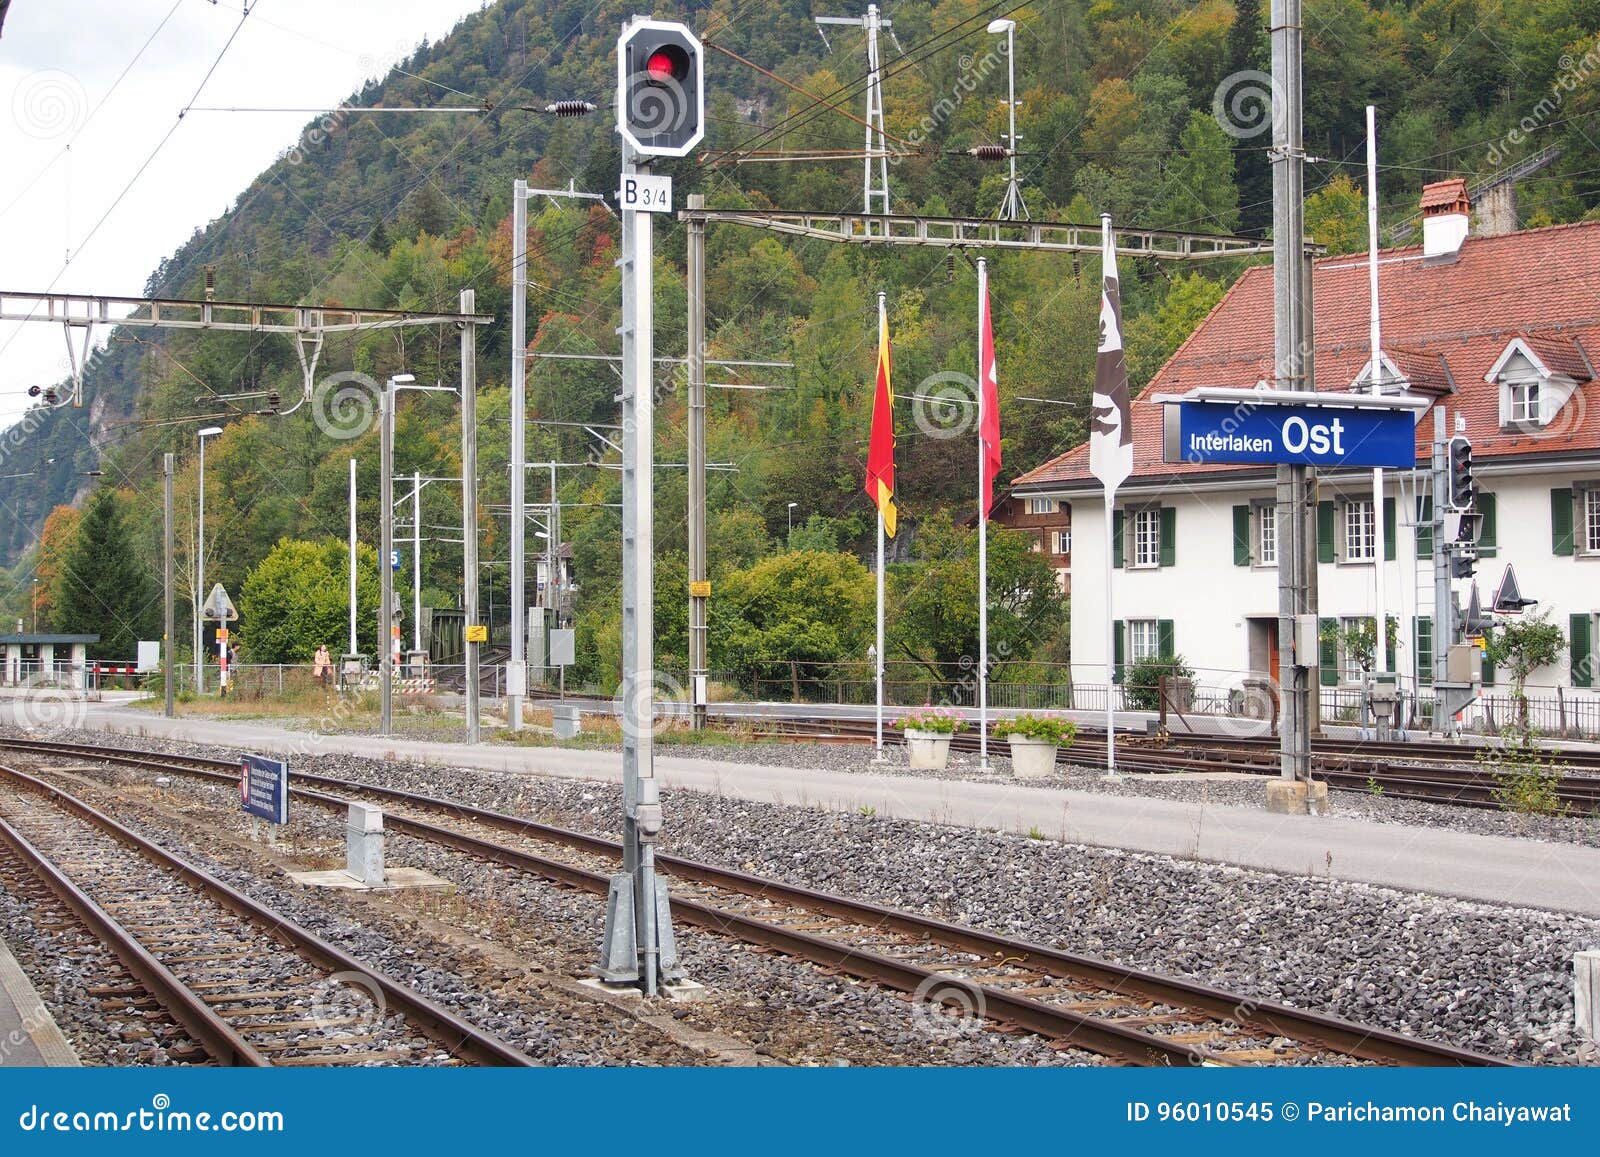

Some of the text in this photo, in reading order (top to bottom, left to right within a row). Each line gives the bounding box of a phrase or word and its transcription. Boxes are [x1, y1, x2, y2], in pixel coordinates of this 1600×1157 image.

[626, 180, 666, 205] B 3/4
[1191, 416, 1344, 455] Interlaken Ost
